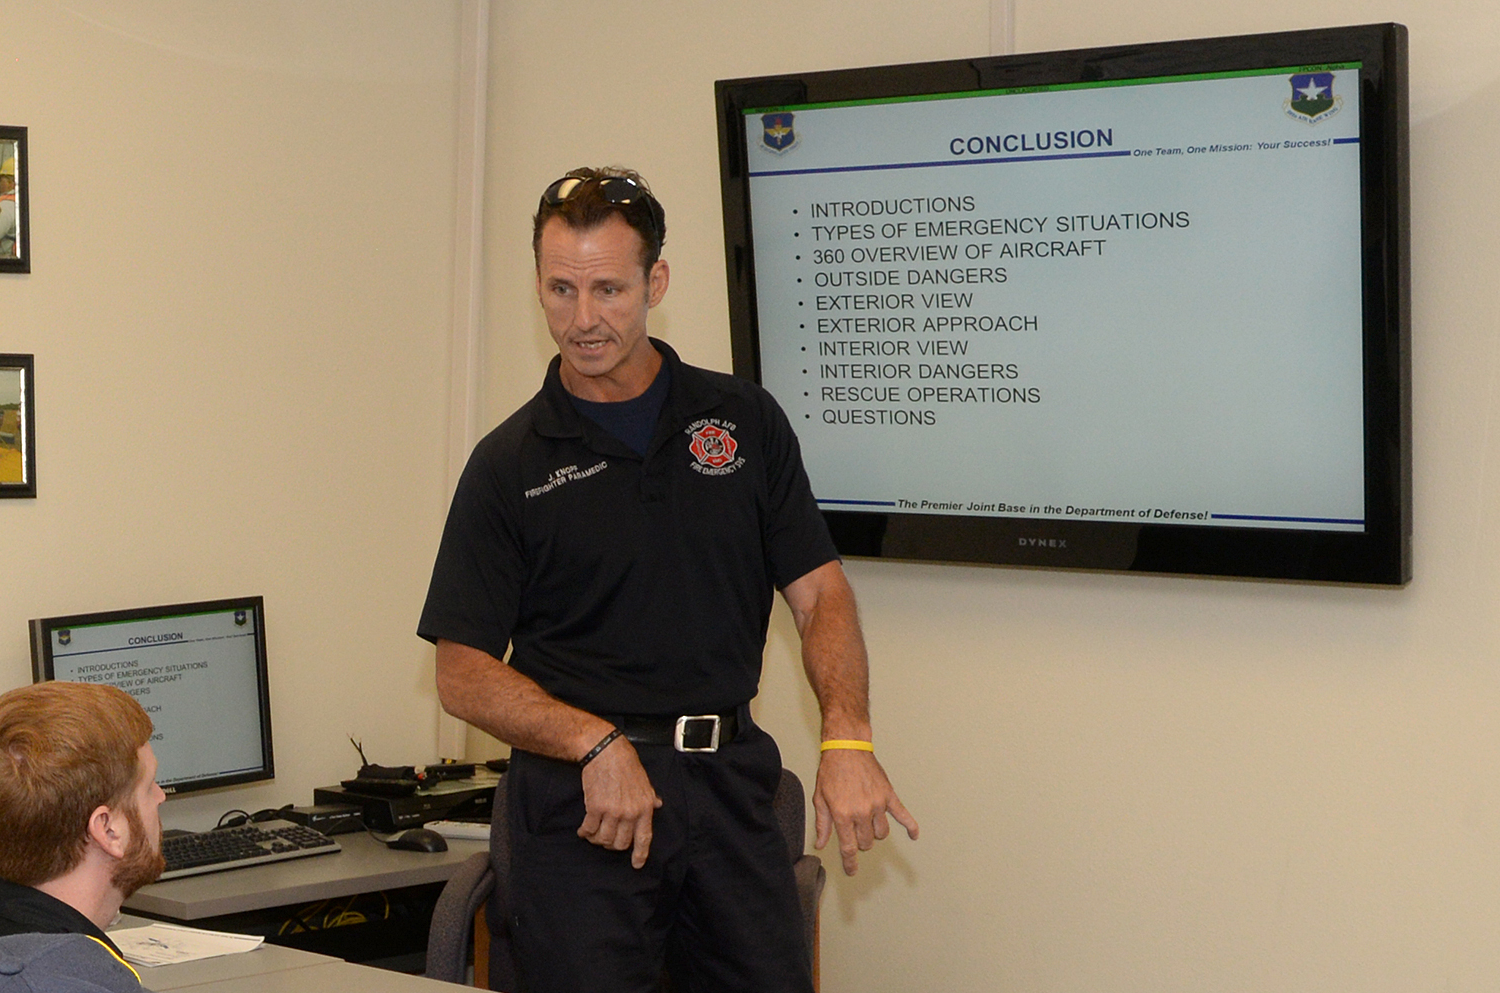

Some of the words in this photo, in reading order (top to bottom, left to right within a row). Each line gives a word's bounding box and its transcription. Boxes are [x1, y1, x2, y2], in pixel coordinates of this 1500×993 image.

[949, 128, 1114, 155] CONCLUSION
[1133, 148, 1153, 157] One
[1156, 146, 1184, 156] Team,
[1186, 145, 1207, 154] One
[1209, 143, 1252, 153] Mission:
[1257, 141, 1280, 150] Your
[1283, 138, 1331, 149] Success!
[810, 196, 975, 218] INTRODUCTIONS
[811, 224, 875, 241] TYPES
[881, 222, 907, 239] OF
[915, 217, 1048, 238] EMERGENCY
[1056, 211, 1190, 232] SITUATIONS
[813, 249, 845, 264] 360
[851, 245, 958, 263] OVERVIEW
[964, 244, 993, 260] OF
[999, 239, 1107, 259] AIRCRAFT
[814, 271, 900, 287] OUTSIDE
[907, 267, 1008, 285] DANGERS
[816, 294, 915, 310] EXTERIOR
[921, 293, 973, 308] VIEW
[817, 317, 916, 333] EXTERIOR
[923, 315, 1038, 332] APPROACH
[819, 341, 911, 356] INTERIOR
[917, 340, 969, 356] VIEW
[820, 364, 912, 379] INTERIOR
[919, 364, 1019, 380] DANGERS
[821, 387, 900, 402] RESCUE
[907, 387, 1041, 404] OPERATIONS
[822, 409, 936, 425] QUESTIONS
[525, 476, 567, 499] FIREFIGHTER
[568, 461, 608, 481] PARAMEDIC
[898, 499, 918, 509] The
[921, 500, 963, 511] Premier
[966, 501, 995, 512] Joint
[998, 503, 1026, 513] Base
[1030, 504, 1040, 514] in
[1043, 504, 1062, 515] the
[1065, 505, 1135, 519] Department
[1138, 508, 1152, 518] of
[1154, 508, 1208, 520] Defense!
[1018, 537, 1068, 549] DYNEX
[128, 632, 183, 646] CONCLUSION
[77, 660, 138, 674] INTRODUCTIONS
[78, 674, 103, 683] TYPES
[104, 672, 116, 680] OF
[117, 666, 164, 679] EMERGENCY
[165, 661, 208, 673] SITUATIONS
[135, 677, 145, 686] OF
[147, 673, 182, 684] AIRCRAFT
